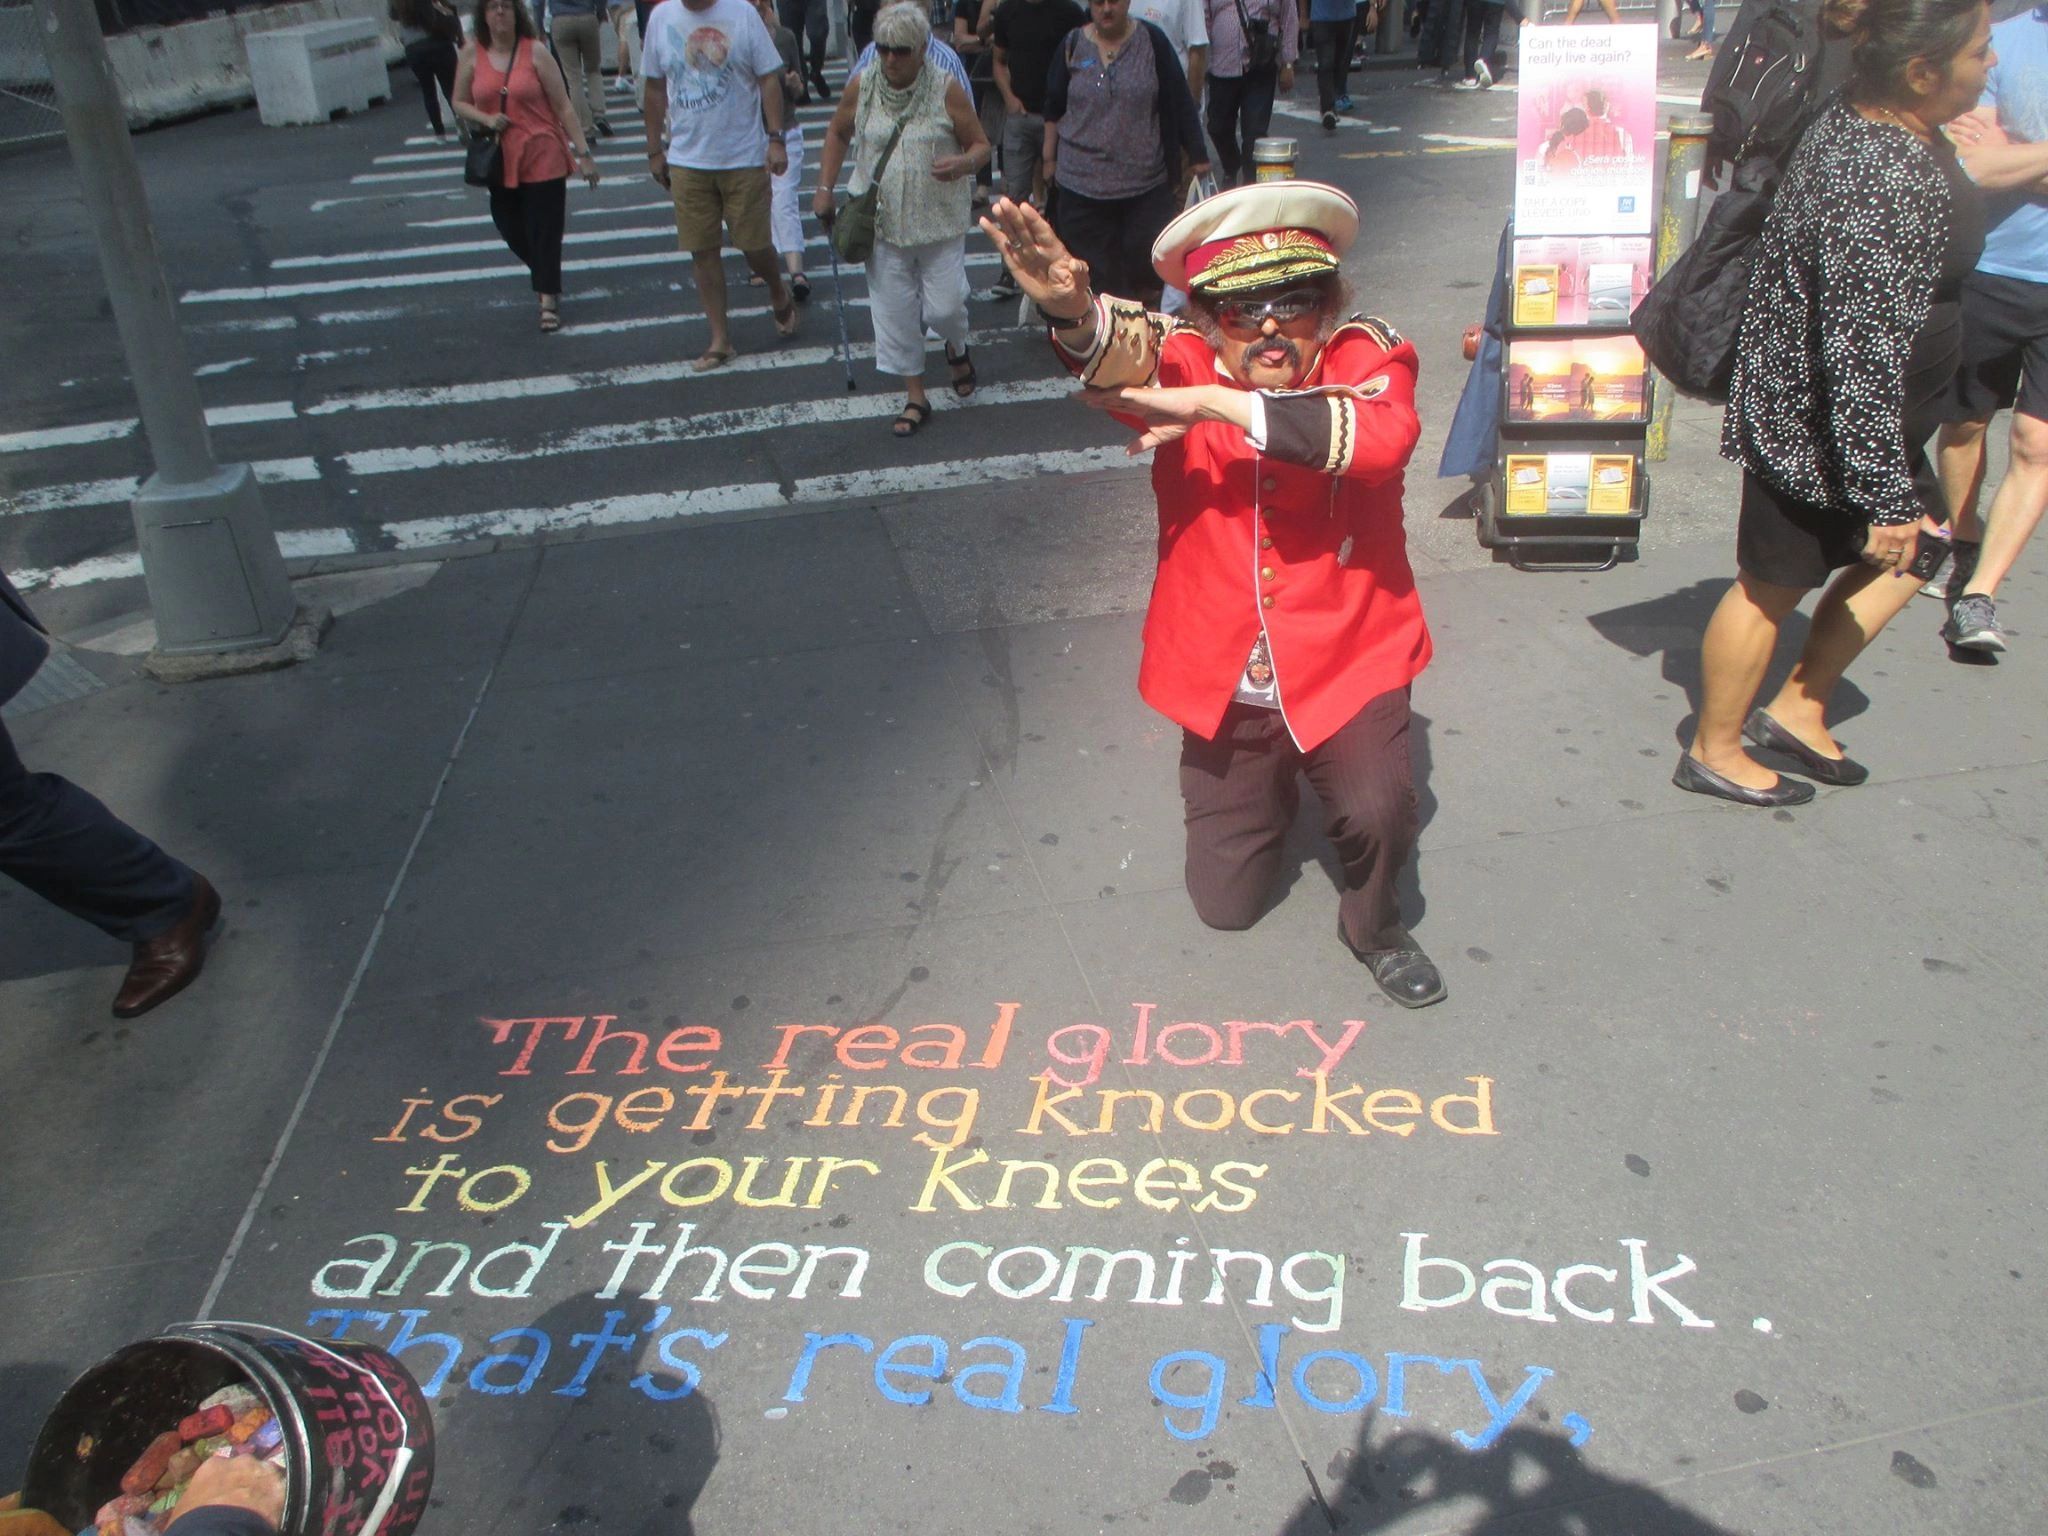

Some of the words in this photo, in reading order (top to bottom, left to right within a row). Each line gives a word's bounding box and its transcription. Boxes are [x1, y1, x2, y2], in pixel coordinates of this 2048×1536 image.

[1528, 37, 1553, 49] Can
[1557, 36, 1577, 48] the
[1581, 35, 1612, 48] dead
[1528, 52, 1563, 67] really
[1565, 51, 1587, 63] live
[1590, 50, 1632, 65] again?
[484, 1014, 722, 1076] The
[761, 1002, 1020, 1070] real
[1039, 1002, 1368, 1087] glory
[372, 1087, 503, 1142] is
[546, 1069, 980, 1154] getting
[1015, 1067, 1501, 1138] knocked
[396, 1153, 532, 1213] to
[565, 1155, 881, 1230] your
[908, 1147, 1269, 1214] knees
[310, 1221, 570, 1300] and
[593, 1220, 871, 1301] then
[923, 1236, 1348, 1334] coming
[306, 1304, 730, 1402] That's
[780, 1317, 1097, 1416] real
[1148, 1322, 1593, 1453] glory,
